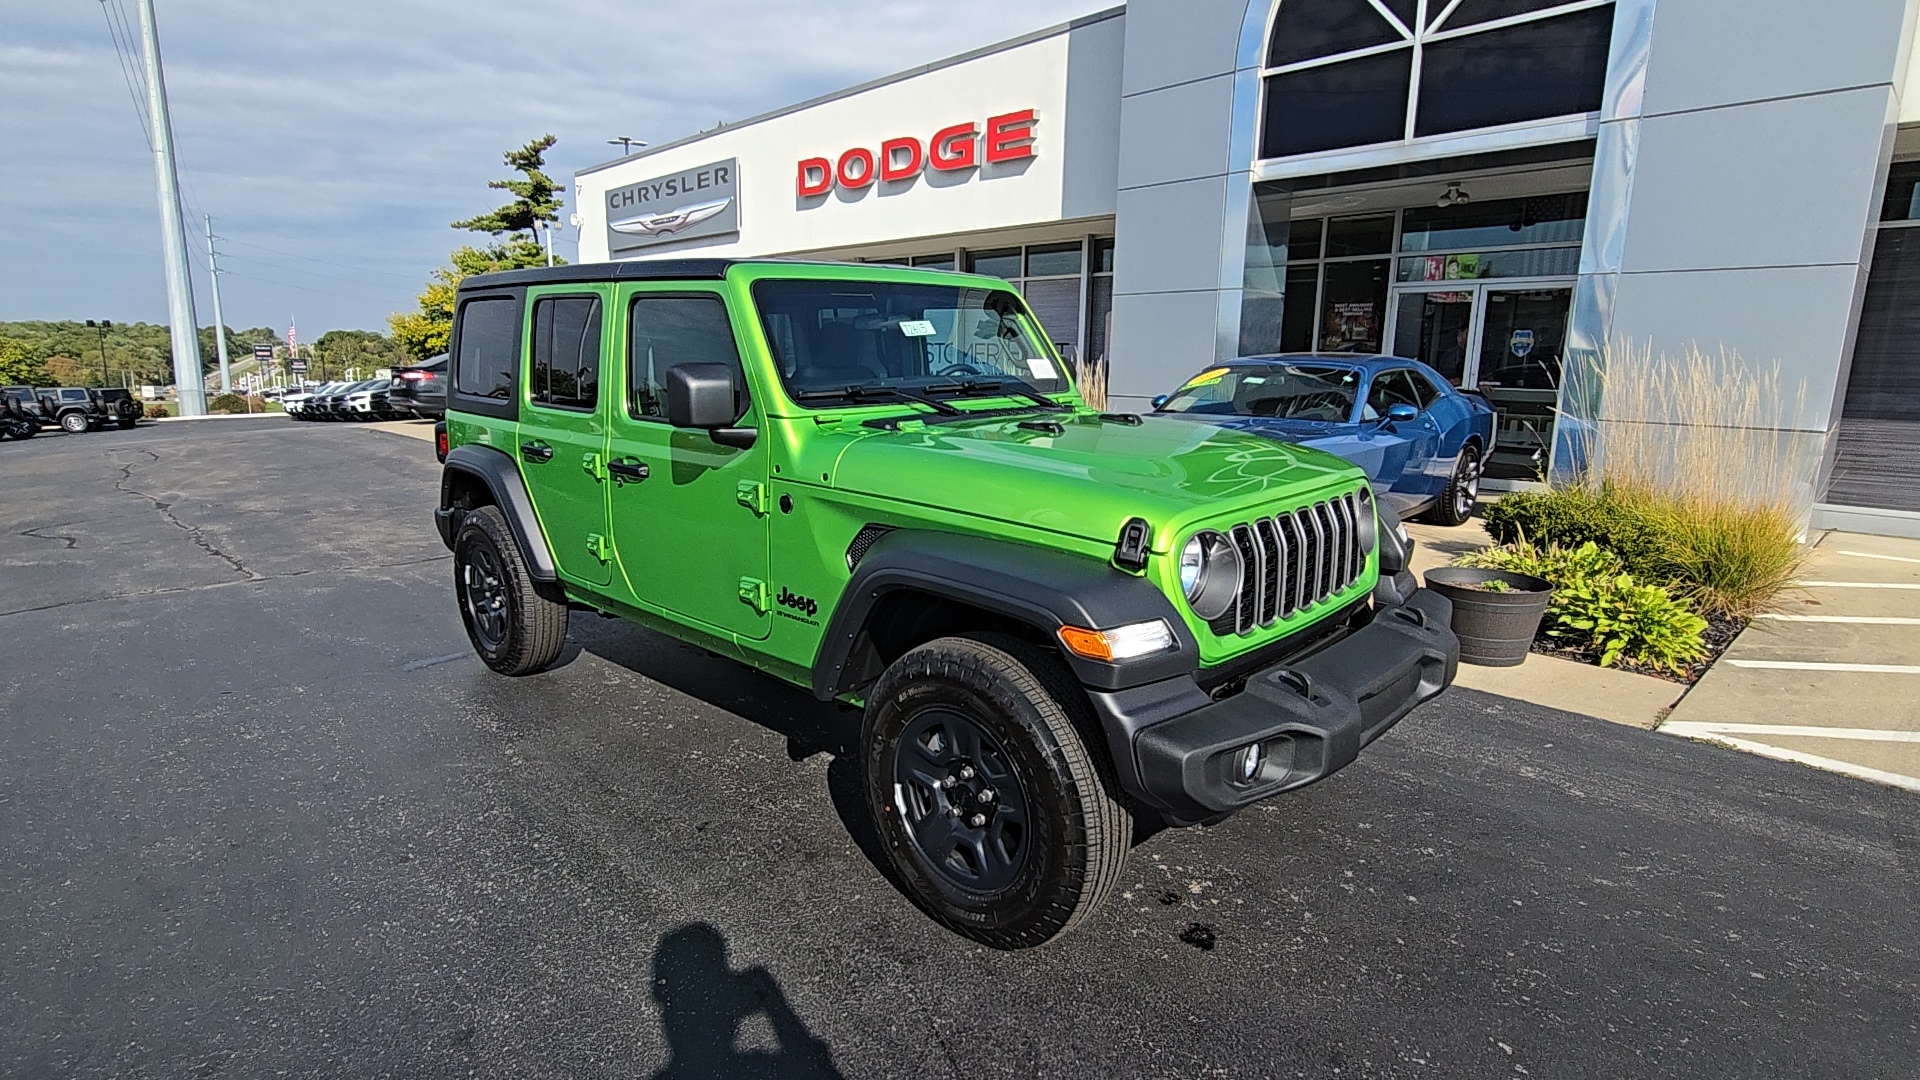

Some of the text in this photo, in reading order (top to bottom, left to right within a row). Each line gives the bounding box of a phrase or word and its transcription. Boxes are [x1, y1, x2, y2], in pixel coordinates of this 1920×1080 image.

[798, 109, 1037, 196] DODGE
[610, 166, 729, 209] CHRYSLER
[776, 586, 818, 617] Jeep
